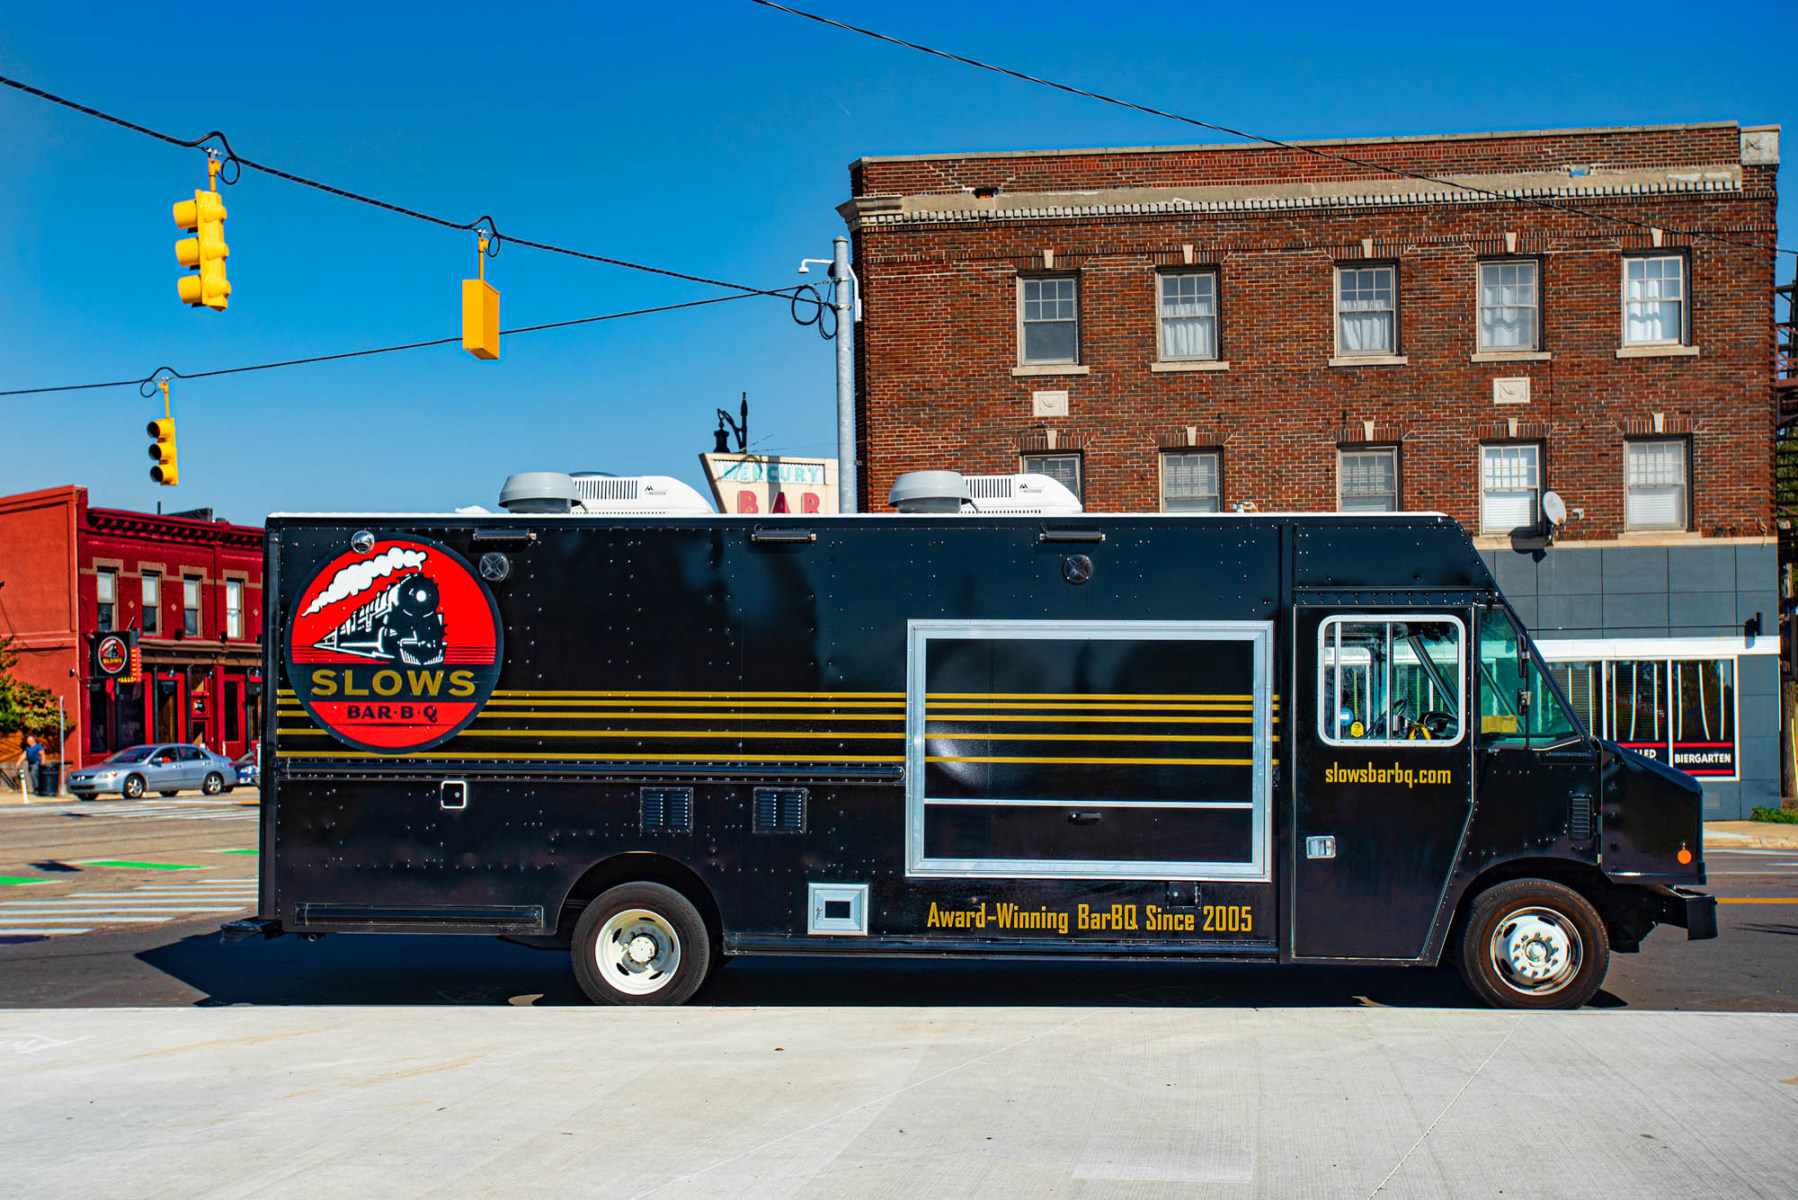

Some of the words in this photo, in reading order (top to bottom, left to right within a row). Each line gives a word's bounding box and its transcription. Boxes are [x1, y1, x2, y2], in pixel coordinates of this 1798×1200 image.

[723, 463, 821, 483] MERCURY
[737, 490, 821, 514] BAR
[310, 669, 476, 697] SLOWS
[1674, 753, 1732, 764] BIERGARTEN
[1325, 761, 1452, 789] slowsbarbq.com
[927, 901, 1069, 935] Award-Winning
[1077, 903, 1139, 931] BarBQ
[1145, 904, 1195, 931] Since
[1202, 905, 1253, 932] 2005
